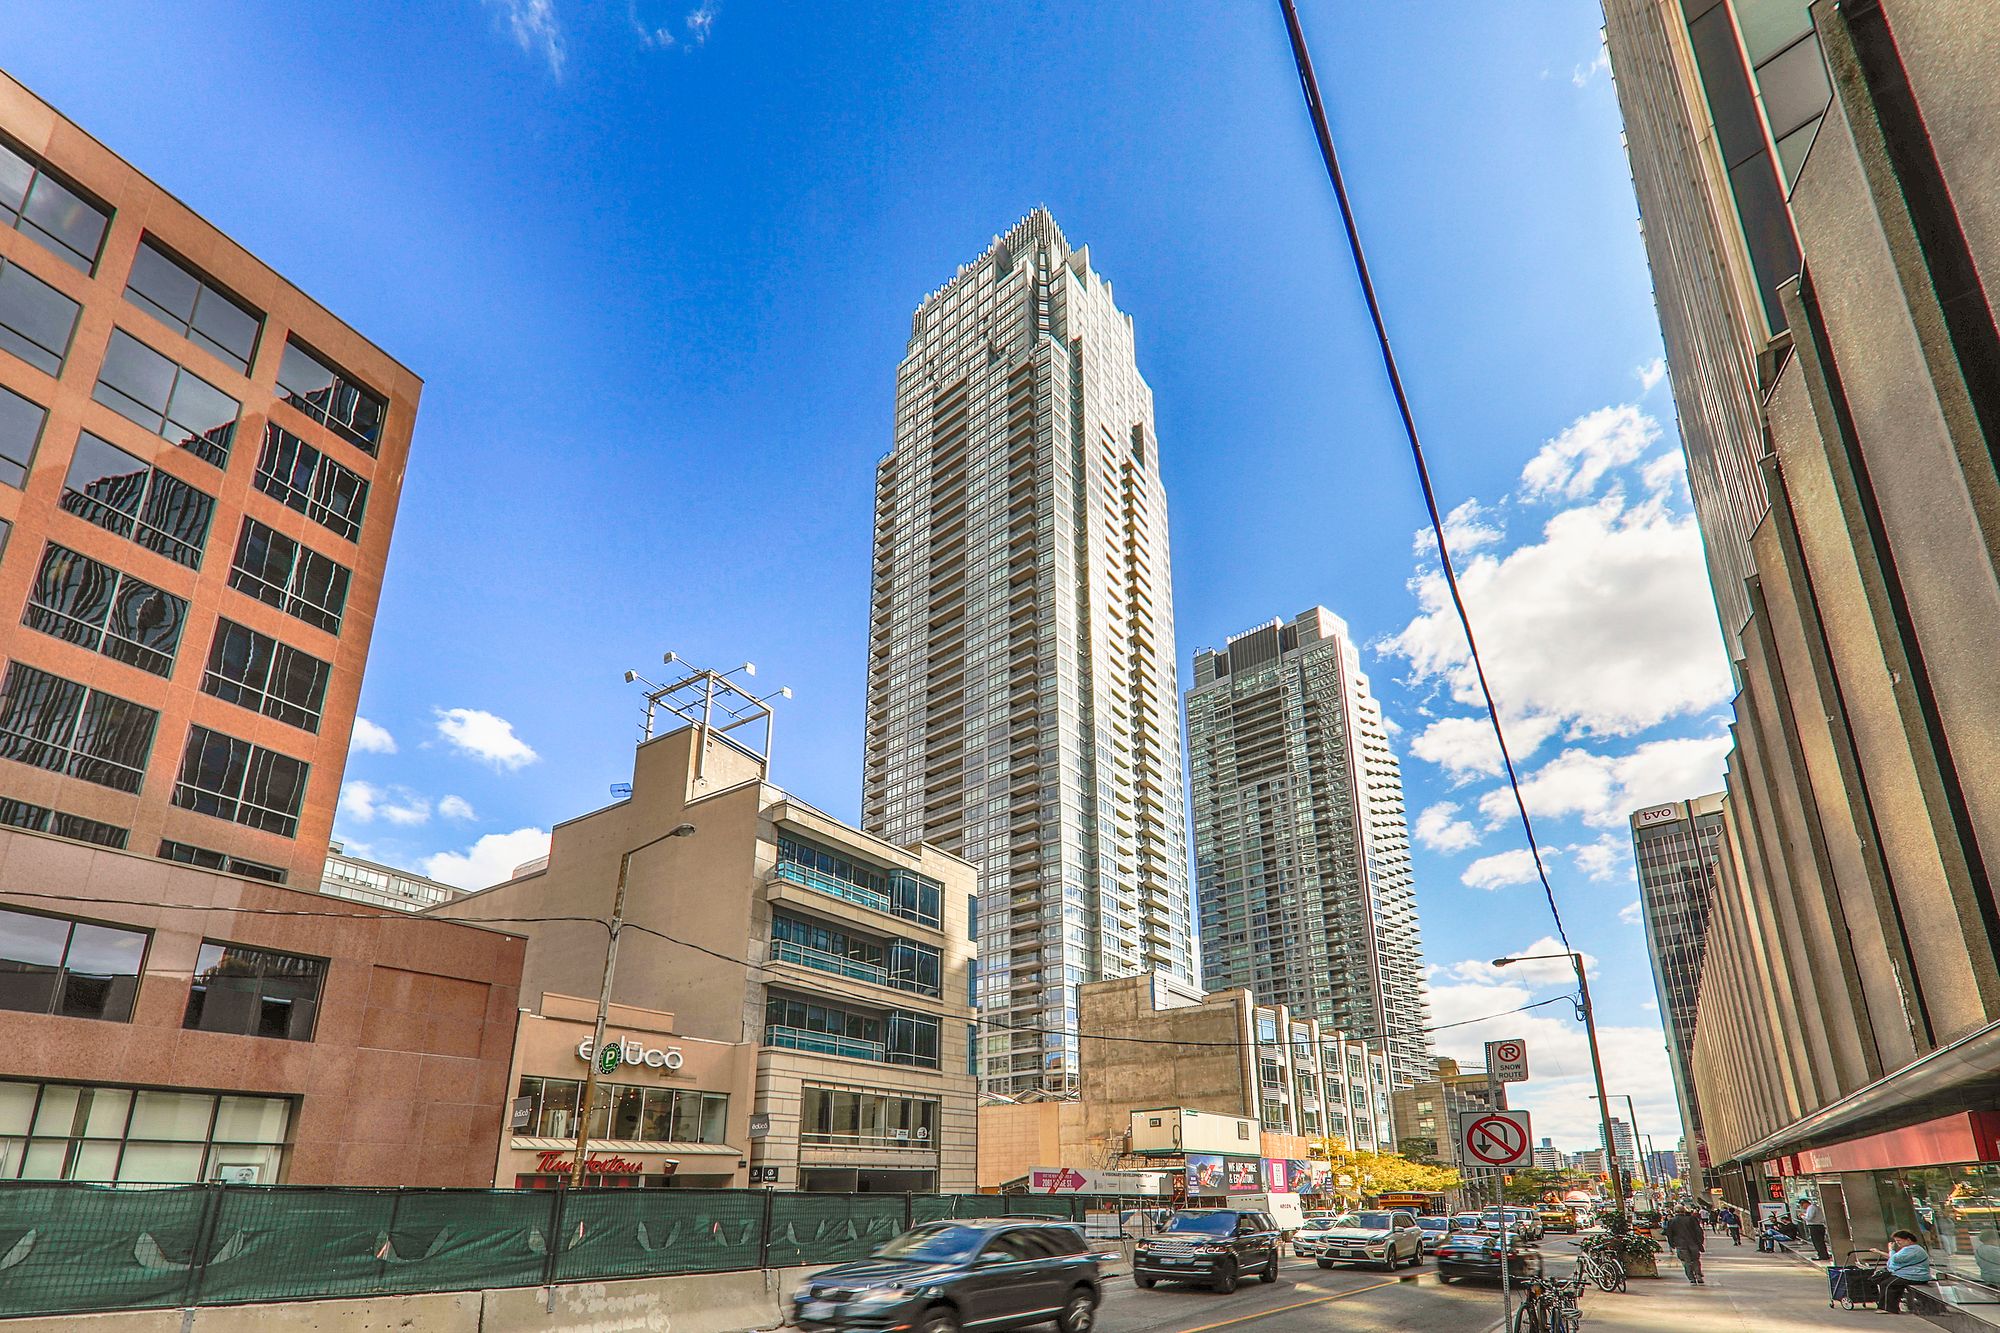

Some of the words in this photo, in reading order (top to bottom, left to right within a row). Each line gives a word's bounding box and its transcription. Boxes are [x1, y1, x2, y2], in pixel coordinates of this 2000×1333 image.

[1643, 808, 1671, 820] tvo
[578, 1035, 683, 1069] ēūcō
[536, 1151, 575, 1172] Tim
